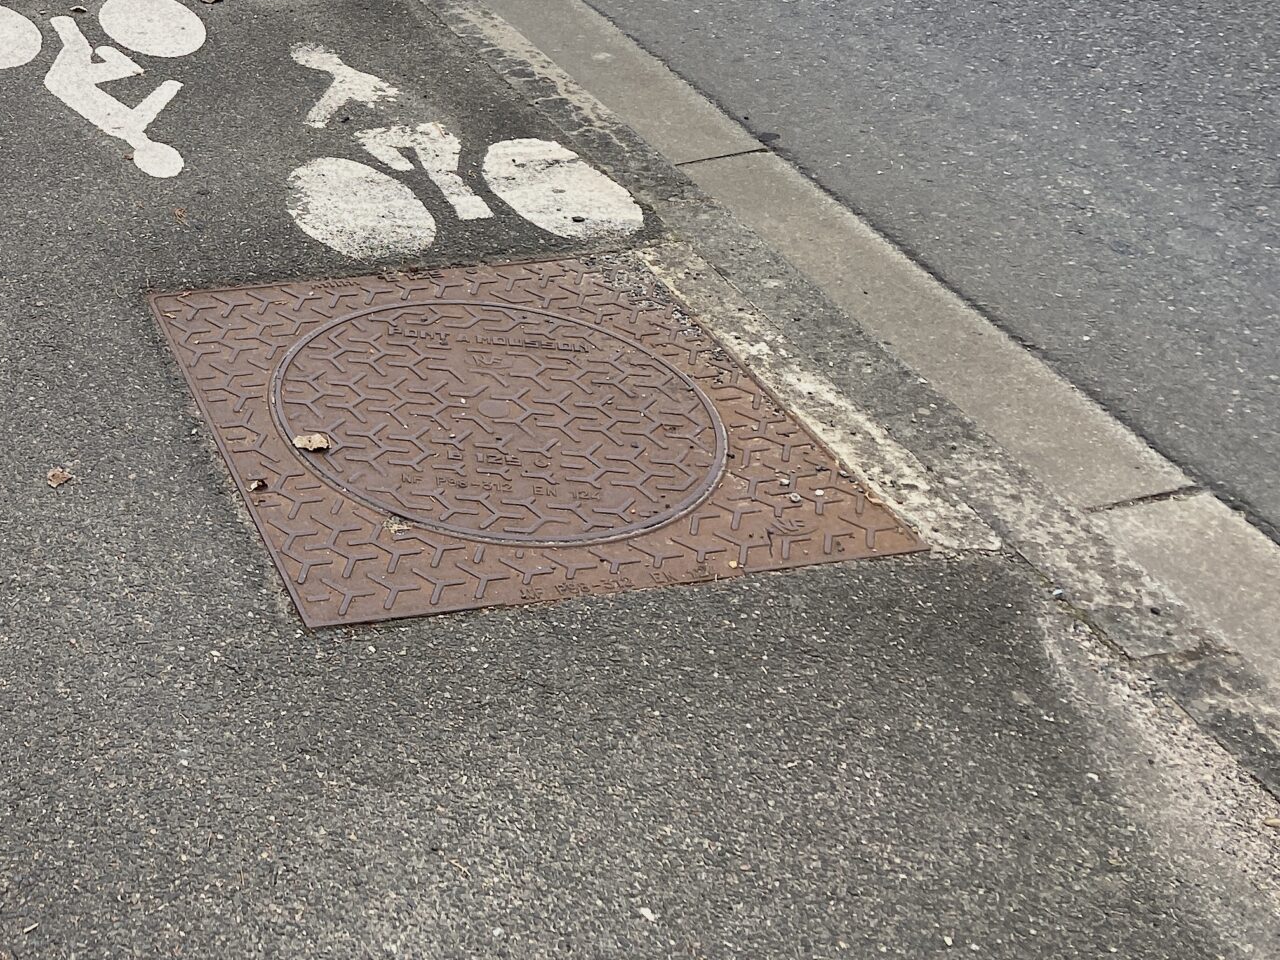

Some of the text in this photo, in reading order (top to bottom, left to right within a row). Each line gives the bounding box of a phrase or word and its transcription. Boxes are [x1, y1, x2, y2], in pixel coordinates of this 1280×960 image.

[387, 325, 591, 354] PONT A MOUSSON
[532, 485, 558, 498] EN
